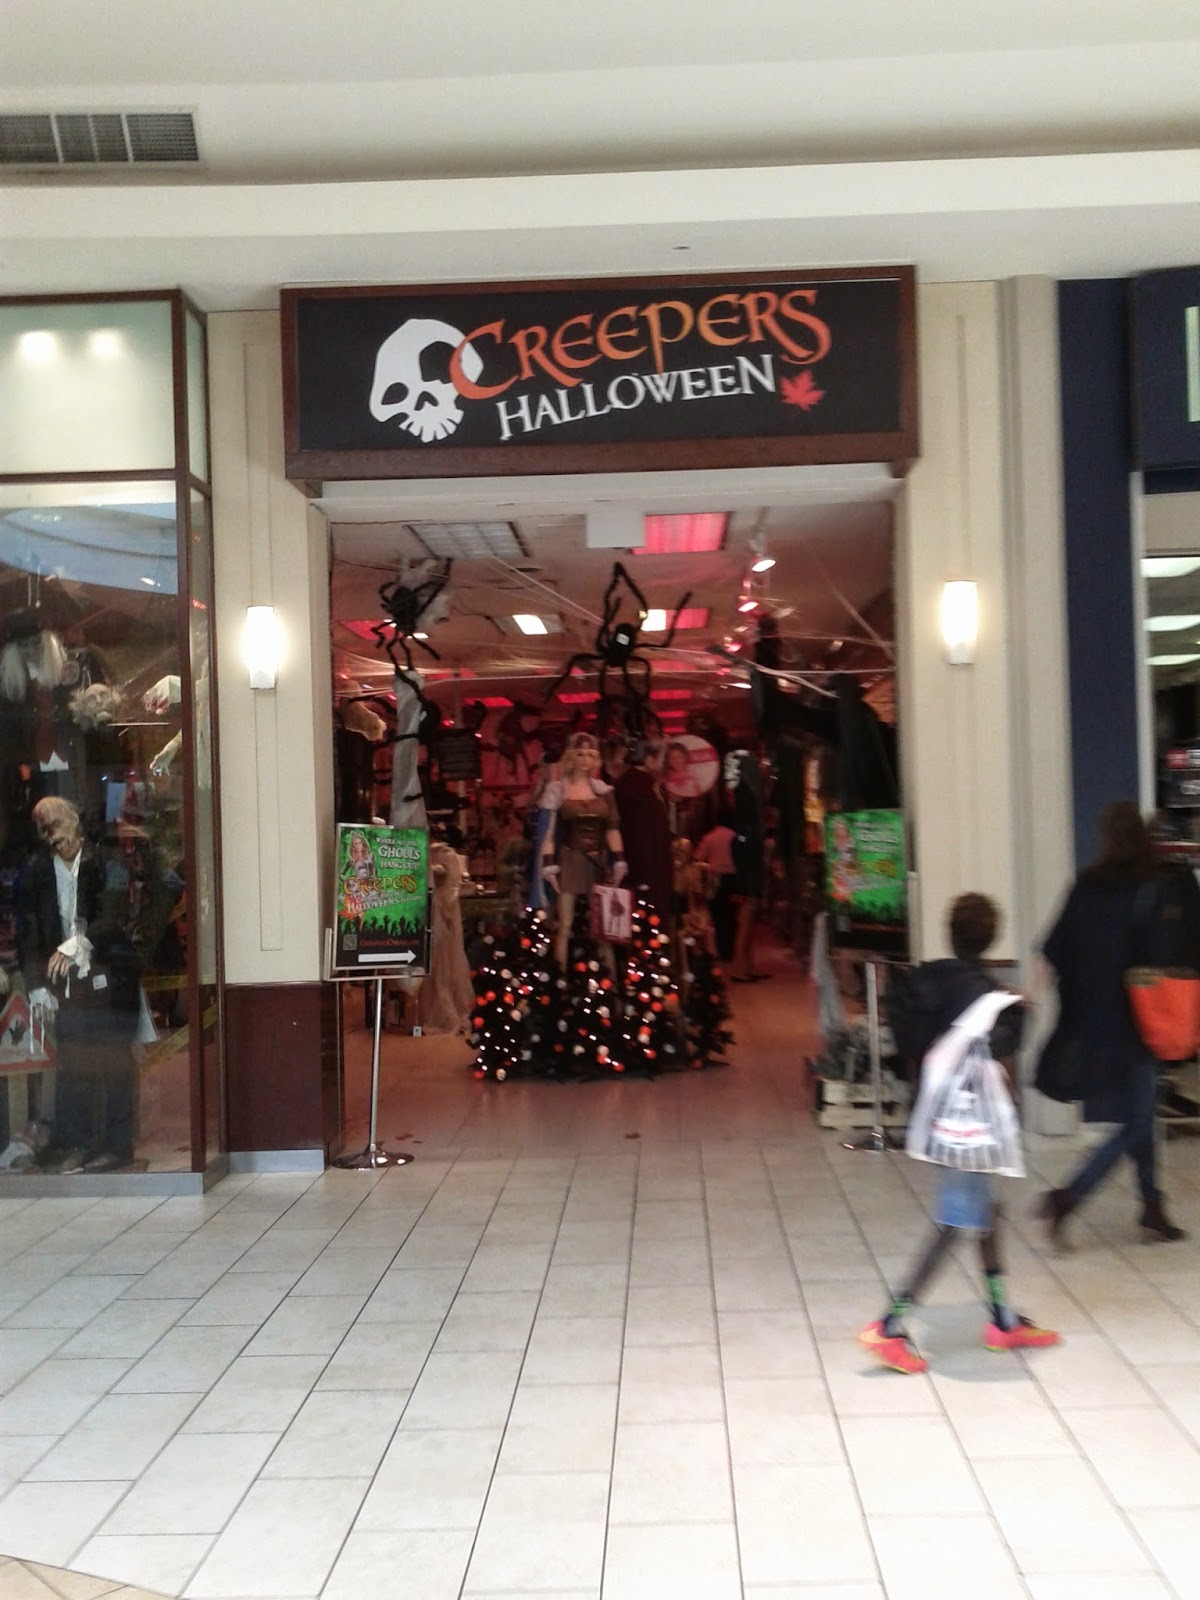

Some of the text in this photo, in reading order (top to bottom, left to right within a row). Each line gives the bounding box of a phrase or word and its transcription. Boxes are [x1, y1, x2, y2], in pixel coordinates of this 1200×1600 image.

[450, 290, 831, 400] CREEPERS
[496, 354, 777, 441] HALLOWEEN
[378, 845, 421, 861] GHOULS
[381, 860, 403, 869] HANG
[344, 875, 417, 895] CREEPERS
